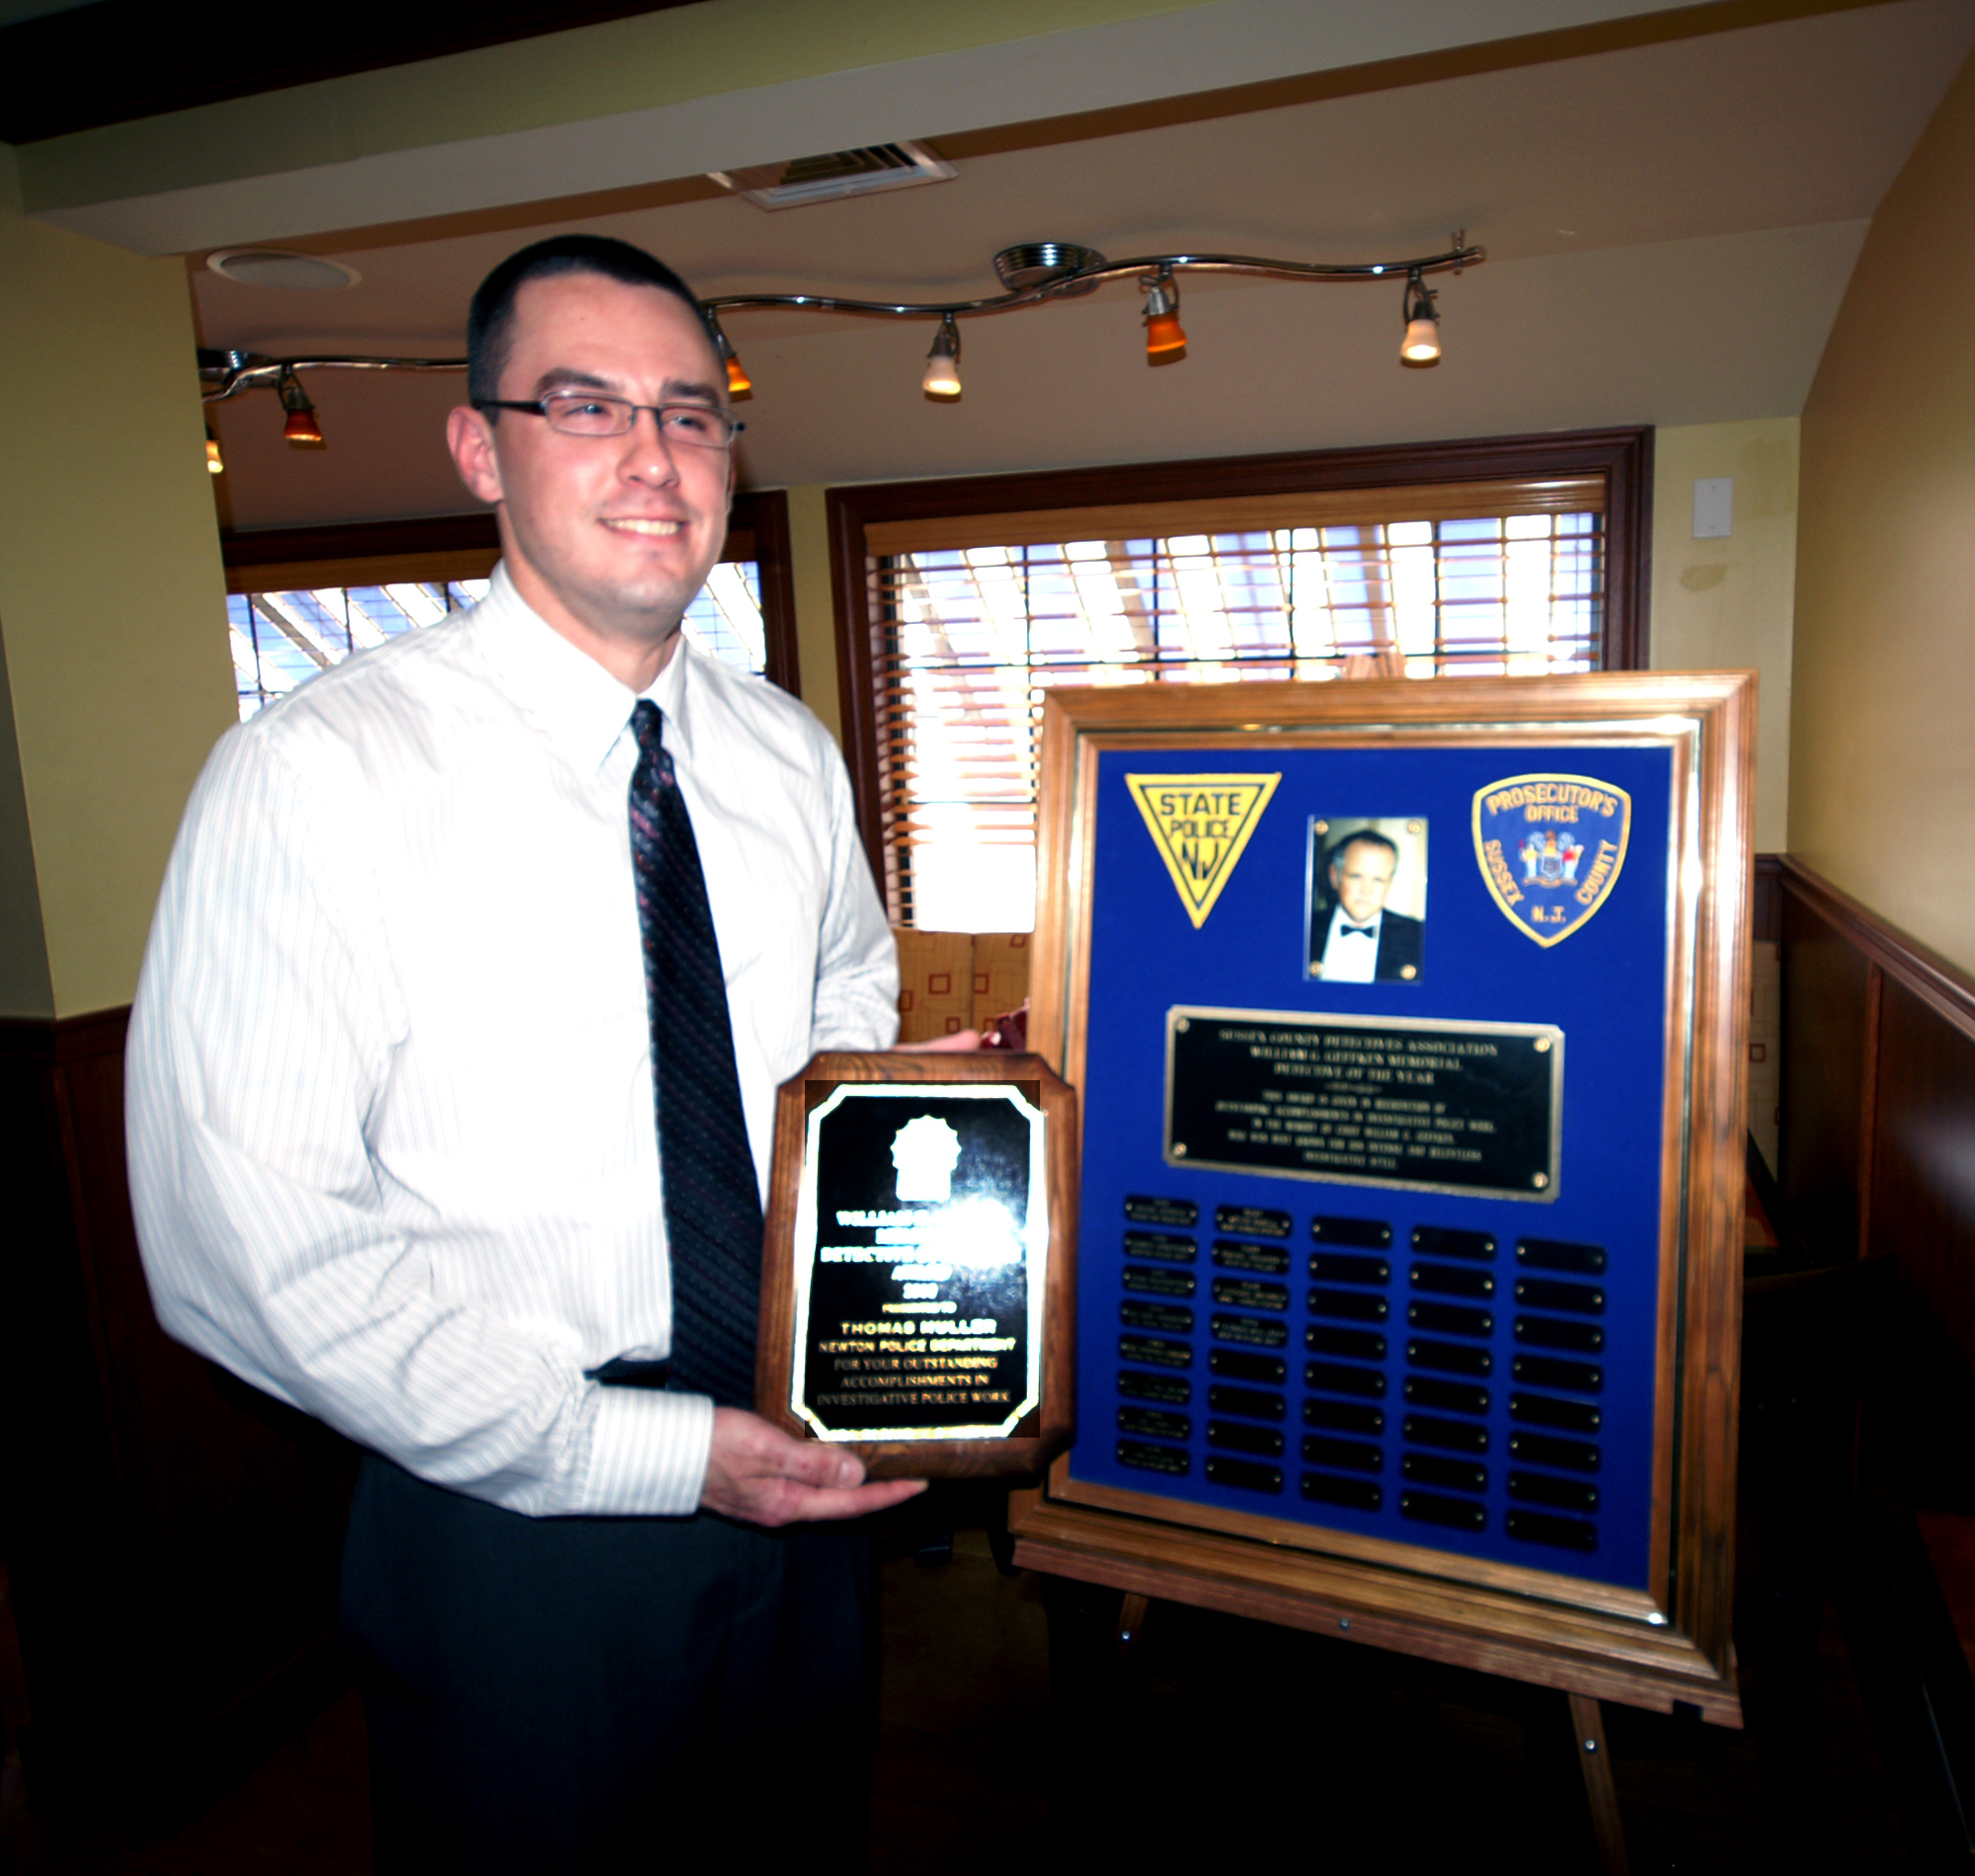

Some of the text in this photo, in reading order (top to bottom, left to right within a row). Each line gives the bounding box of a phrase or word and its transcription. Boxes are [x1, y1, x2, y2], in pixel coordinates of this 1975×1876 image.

[1160, 793, 1241, 816] STATE
[1485, 782, 1619, 818] PROSECUTOR'S
[1525, 805, 1579, 823] OFFICE
[1170, 820, 1230, 839] POLICE
[1484, 839, 1525, 906] SUSSEX
[1575, 839, 1618, 905] COUNTY
[1533, 905, 1566, 923] N.J.
[1408, 1040, 1498, 1056] ASSOCIATION
[841, 1320, 915, 1335] THOMAS
[819, 1340, 876, 1353] NEWTON
[879, 1339, 927, 1353] POLICE
[834, 1357, 998, 1370] FOR YOUR OUTSTANDING
[841, 1373, 989, 1387] ACCOMPLISHMENTS IN
[817, 1391, 1011, 1406] INVESTIGATIVE POLICE WORK
